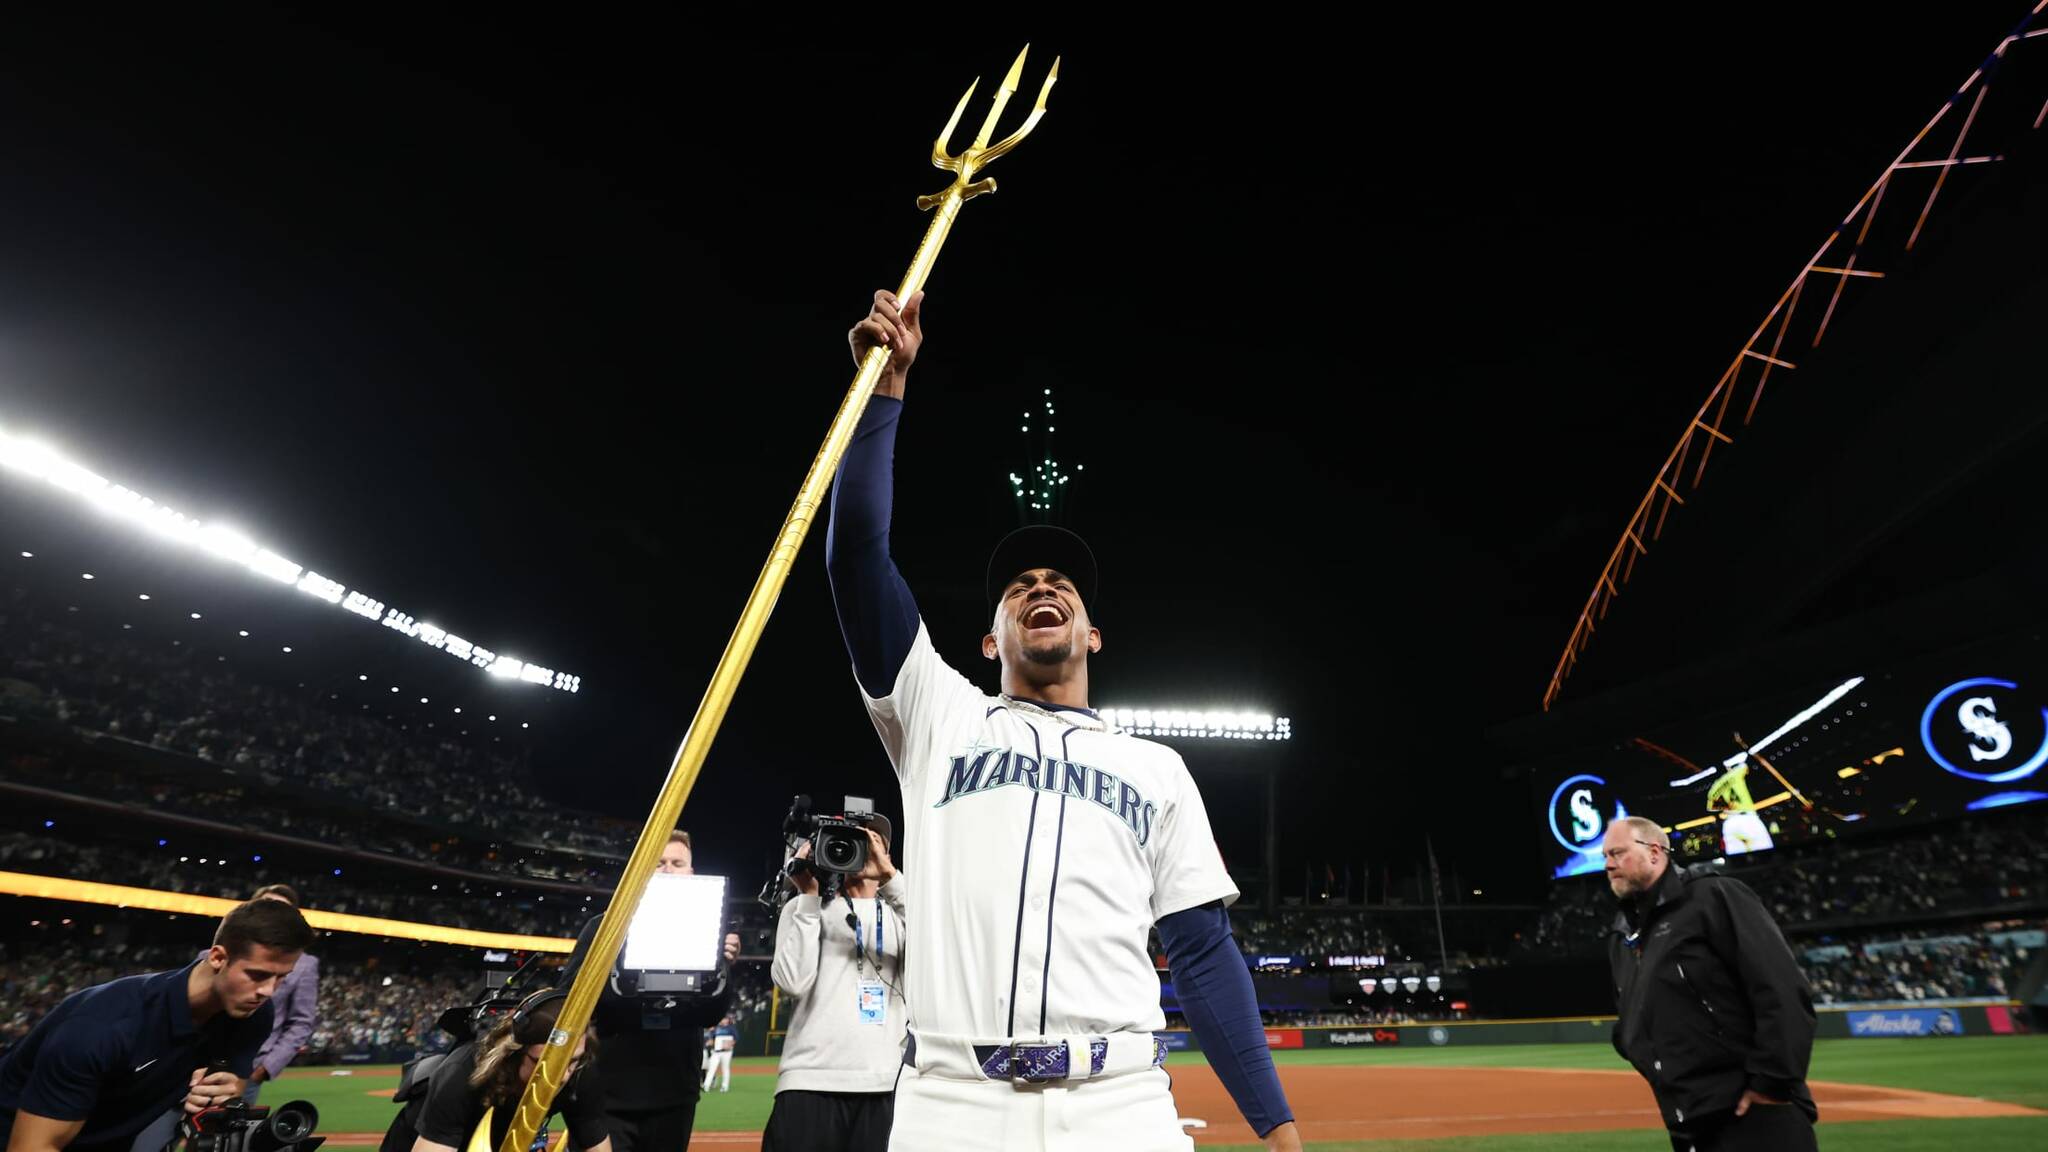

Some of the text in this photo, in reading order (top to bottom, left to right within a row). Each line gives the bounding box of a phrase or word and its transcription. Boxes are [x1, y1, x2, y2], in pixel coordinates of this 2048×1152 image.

[1958, 697, 2012, 761] S
[933, 746, 1158, 848] MARINERS
[1570, 789, 1602, 842] S
[1330, 1032, 1375, 1045] KeyBank
